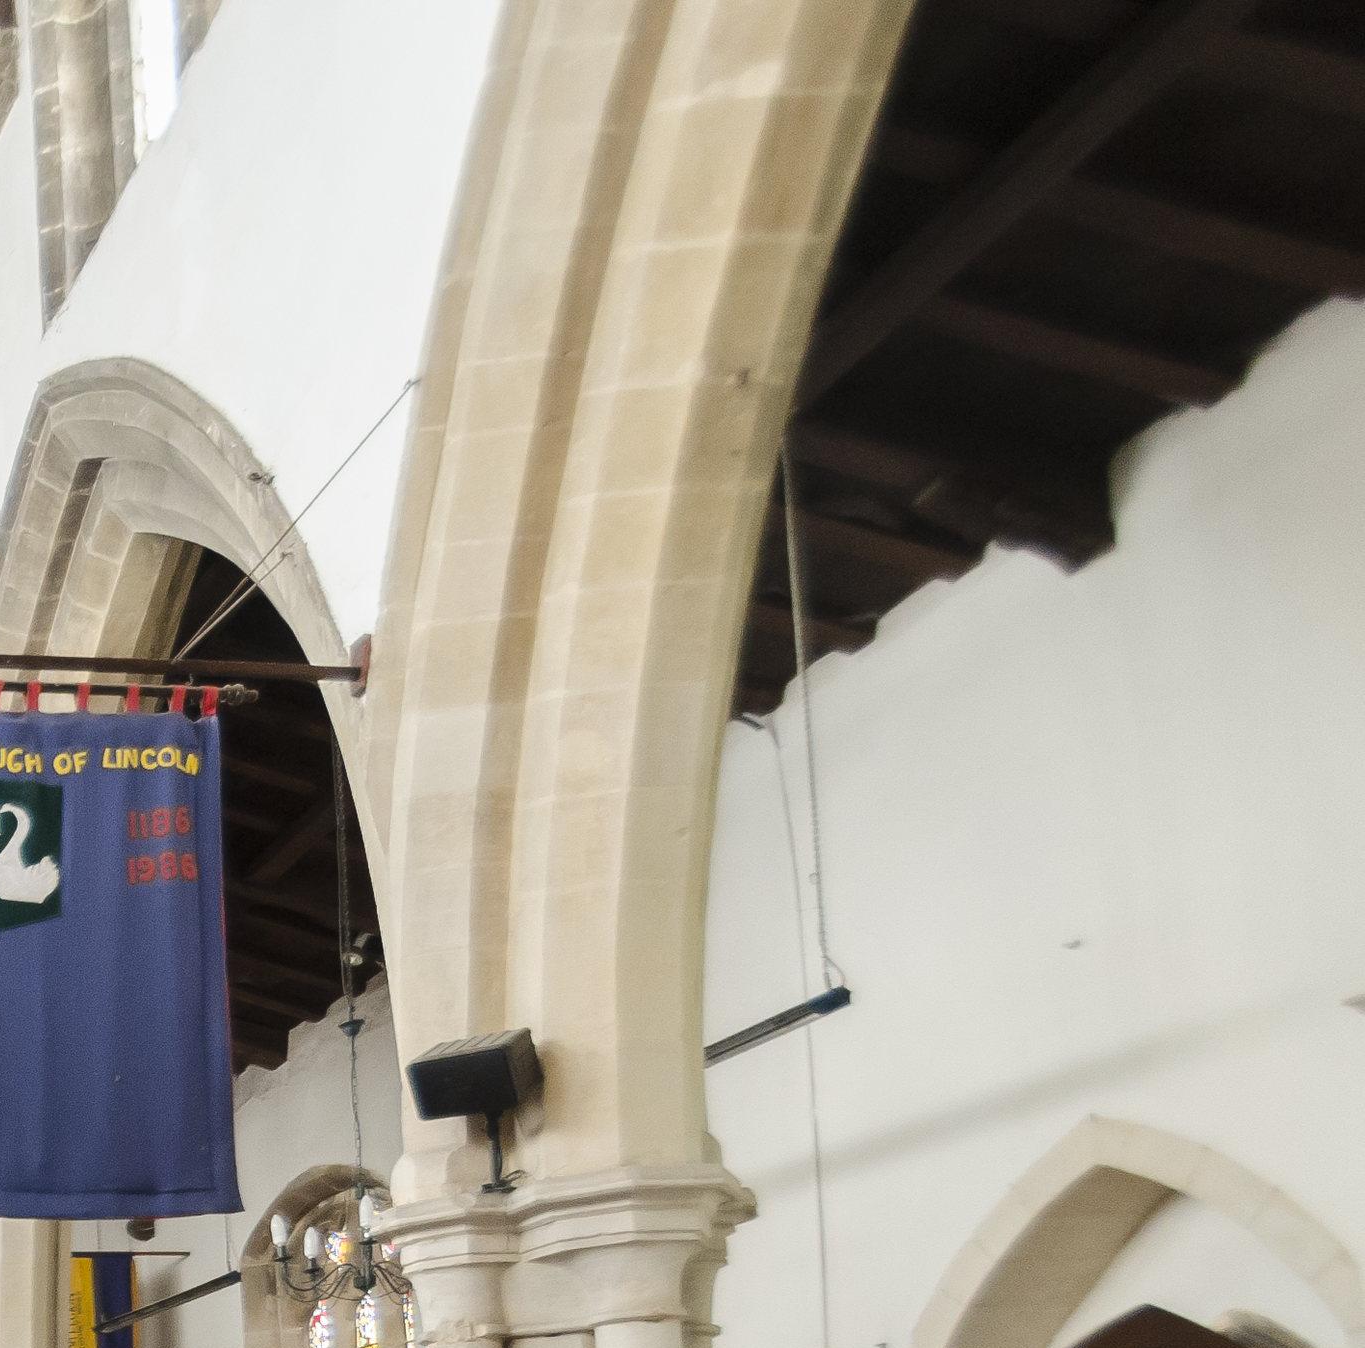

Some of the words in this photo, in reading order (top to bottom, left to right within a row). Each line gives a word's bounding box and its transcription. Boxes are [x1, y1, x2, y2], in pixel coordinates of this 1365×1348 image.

[52, 750, 90, 775] OF
[102, 747, 199, 776] LINCOLN
[128, 806, 191, 840] 1186
[127, 852, 198, 885] 1986
